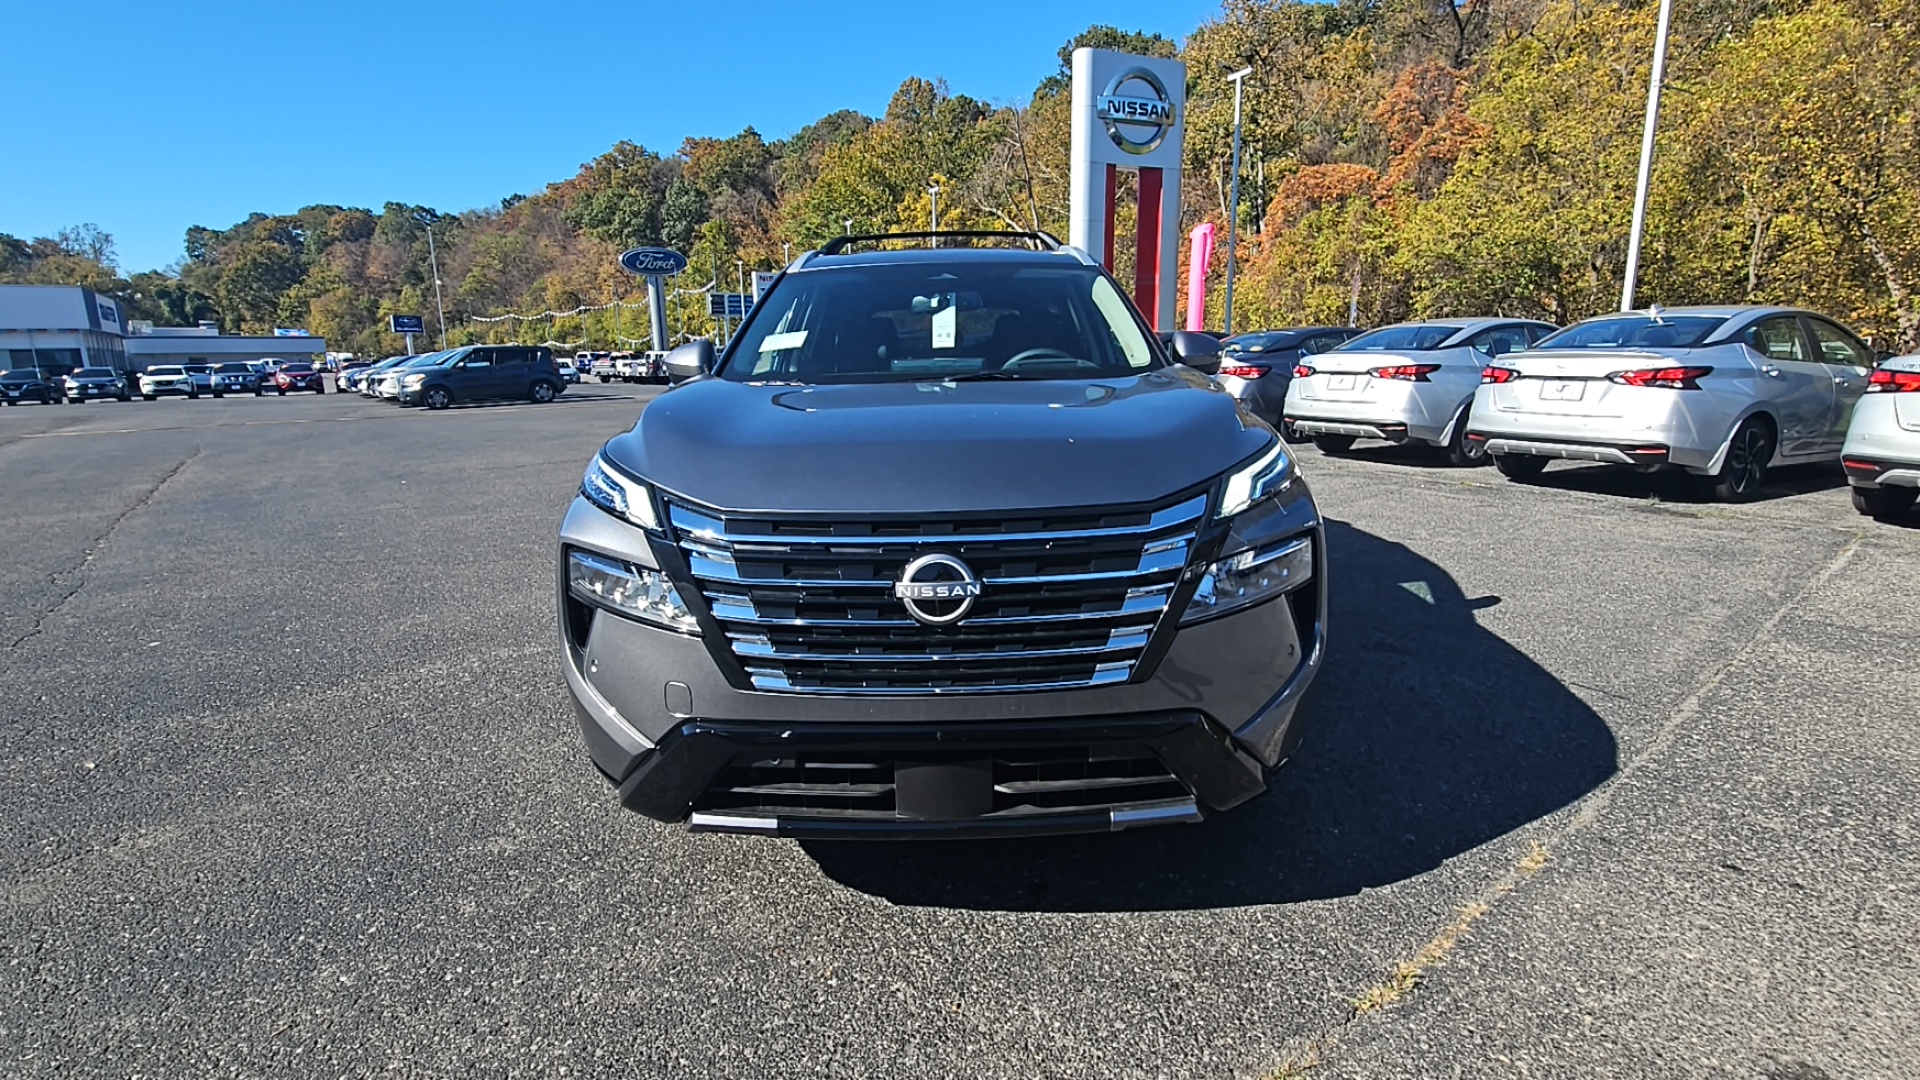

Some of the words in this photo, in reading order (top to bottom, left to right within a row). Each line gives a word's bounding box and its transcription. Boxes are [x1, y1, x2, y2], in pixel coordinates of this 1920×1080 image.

[1107, 100, 1170, 120] NISSAN
[636, 252, 675, 269] Ford
[897, 584, 981, 597] NISSAN
